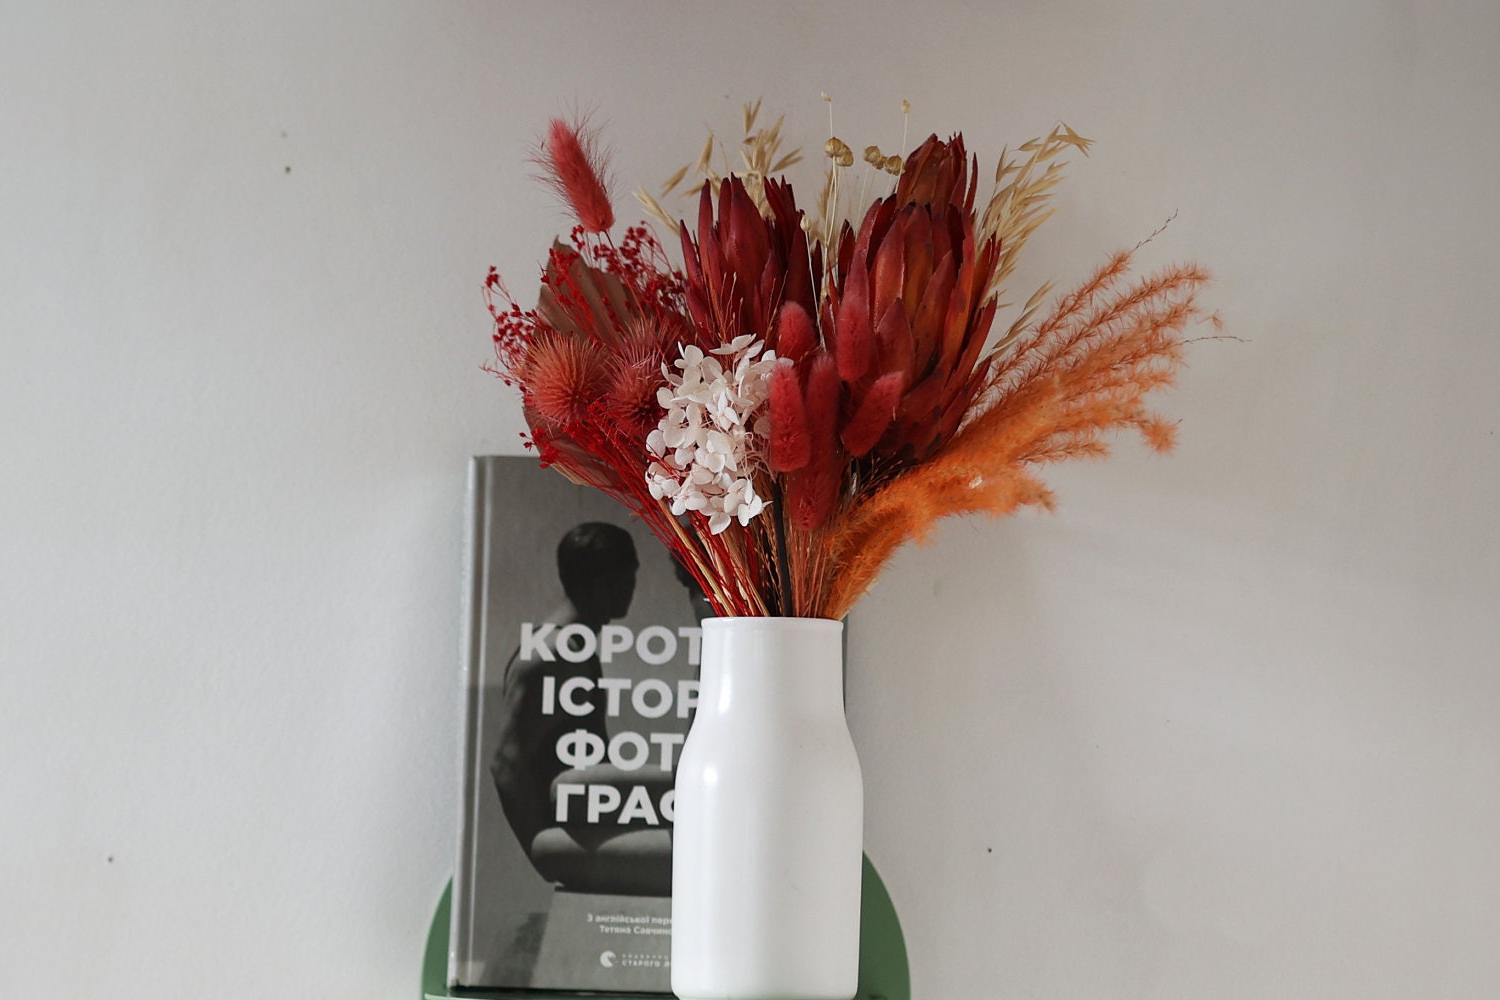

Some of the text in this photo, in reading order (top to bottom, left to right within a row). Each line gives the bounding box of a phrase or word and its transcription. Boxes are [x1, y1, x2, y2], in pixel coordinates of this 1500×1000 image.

[555, 729, 684, 771] ФОТ
[595, 914, 650, 924] англійської
[599, 925, 631, 935] Тетяна
